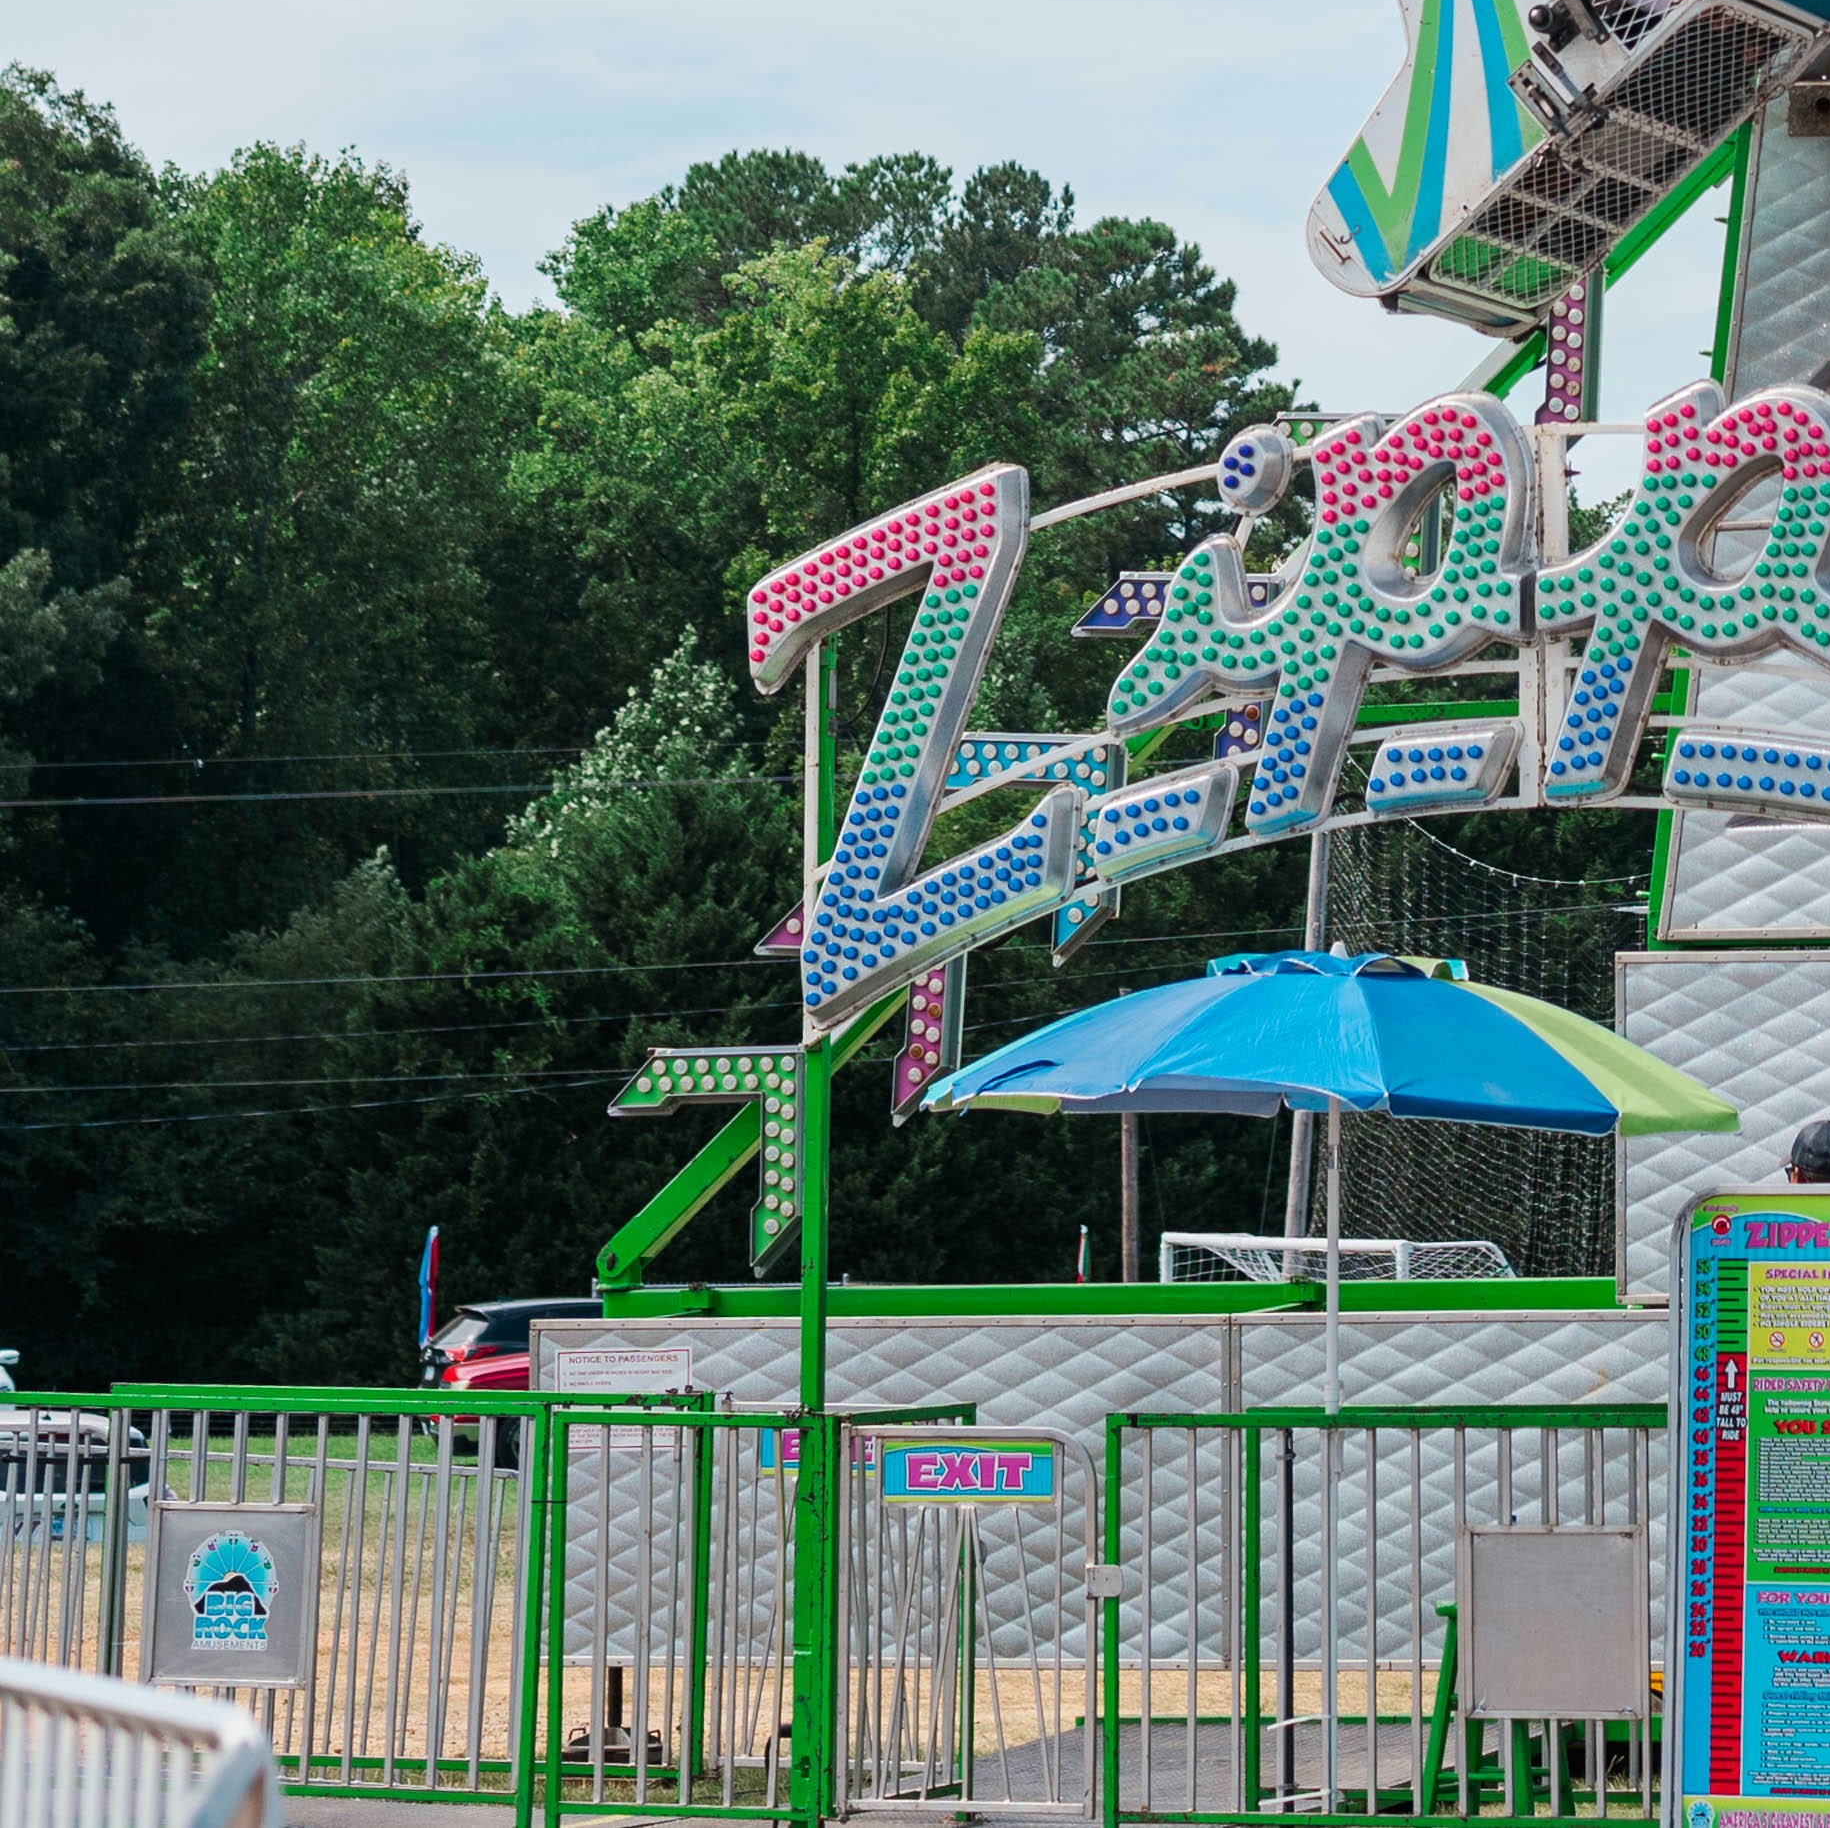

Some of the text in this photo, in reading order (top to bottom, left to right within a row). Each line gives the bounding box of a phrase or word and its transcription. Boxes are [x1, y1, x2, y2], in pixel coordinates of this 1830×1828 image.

[1765, 1268, 1819, 1280] SPECIAL
[569, 1354, 679, 1364] NOTICE TO PASSENGERS
[1753, 1377, 1785, 1392] RIDER
[1787, 1377, 1826, 1392] SAFETY
[1720, 1391, 1742, 1403] MUST
[1716, 1416, 1747, 1429] TALL TO
[1774, 1419, 1817, 1434] YOU
[1721, 1429, 1740, 1441] RIDE
[907, 1452, 1031, 1490] EXIT
[1757, 1591, 1791, 1604] FOR
[205, 1593, 254, 1617] BIG
[195, 1616, 267, 1639] ROCK
[192, 1639, 267, 1650] AMUSEMENTS
